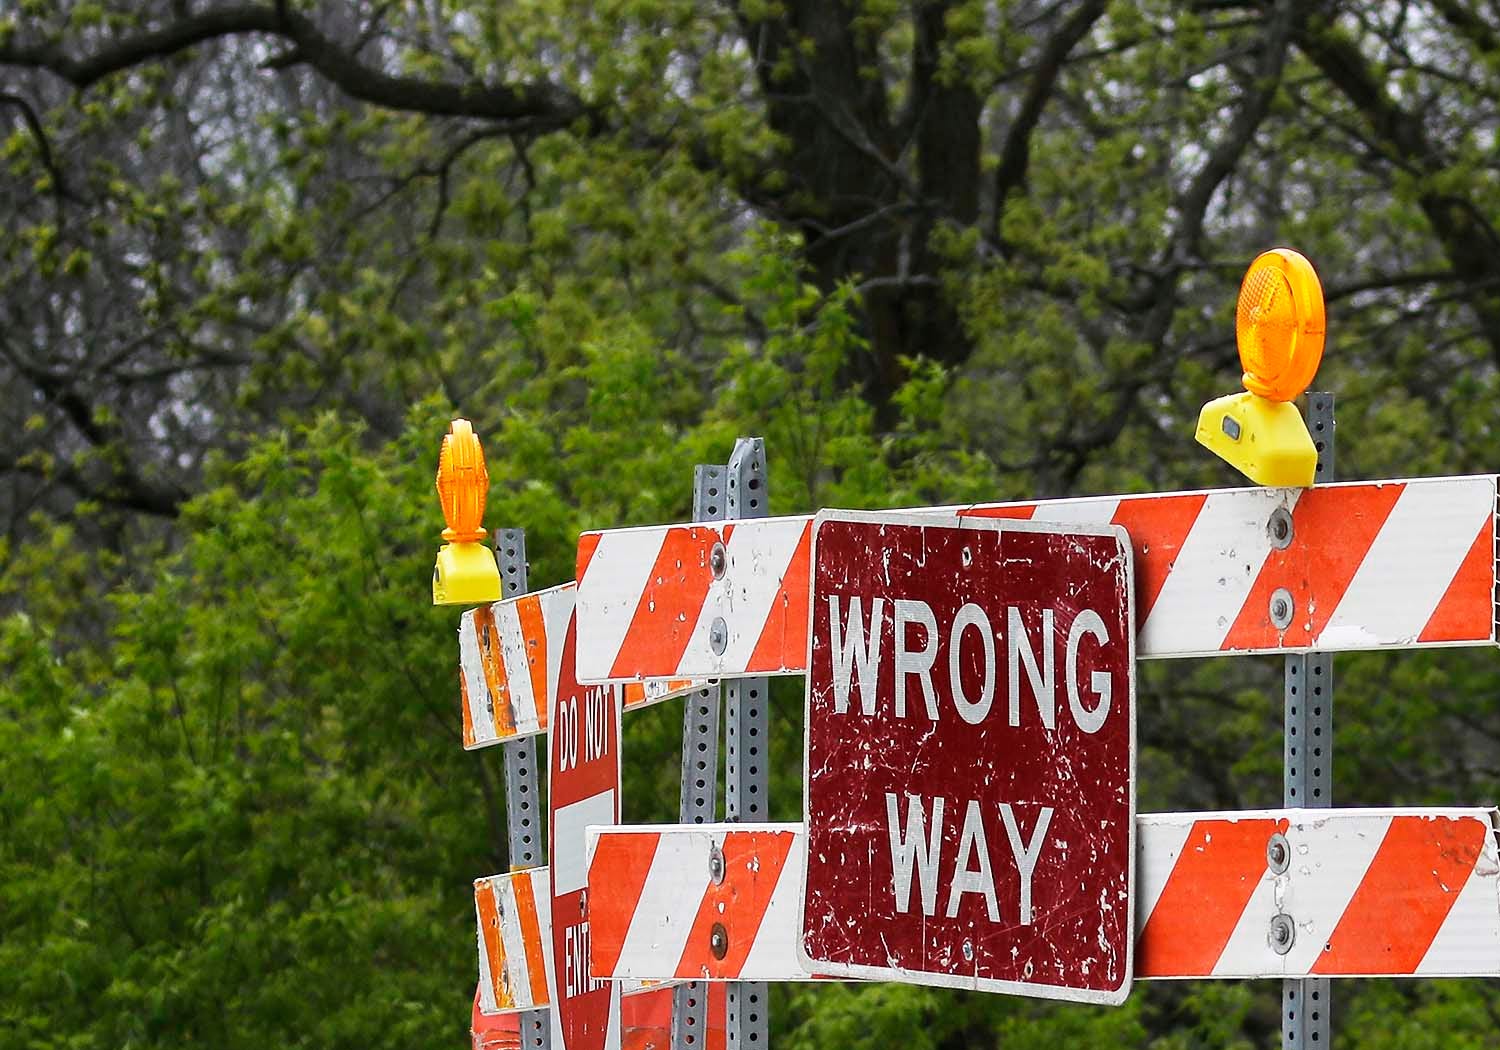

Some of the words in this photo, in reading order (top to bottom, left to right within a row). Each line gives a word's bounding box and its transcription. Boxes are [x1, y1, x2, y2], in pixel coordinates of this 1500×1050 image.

[828, 594, 1113, 735] WRONG
[559, 695, 578, 772] DO
[585, 684, 610, 763] NOT
[885, 792, 1055, 926] WAY
[565, 921, 605, 999] ENT
